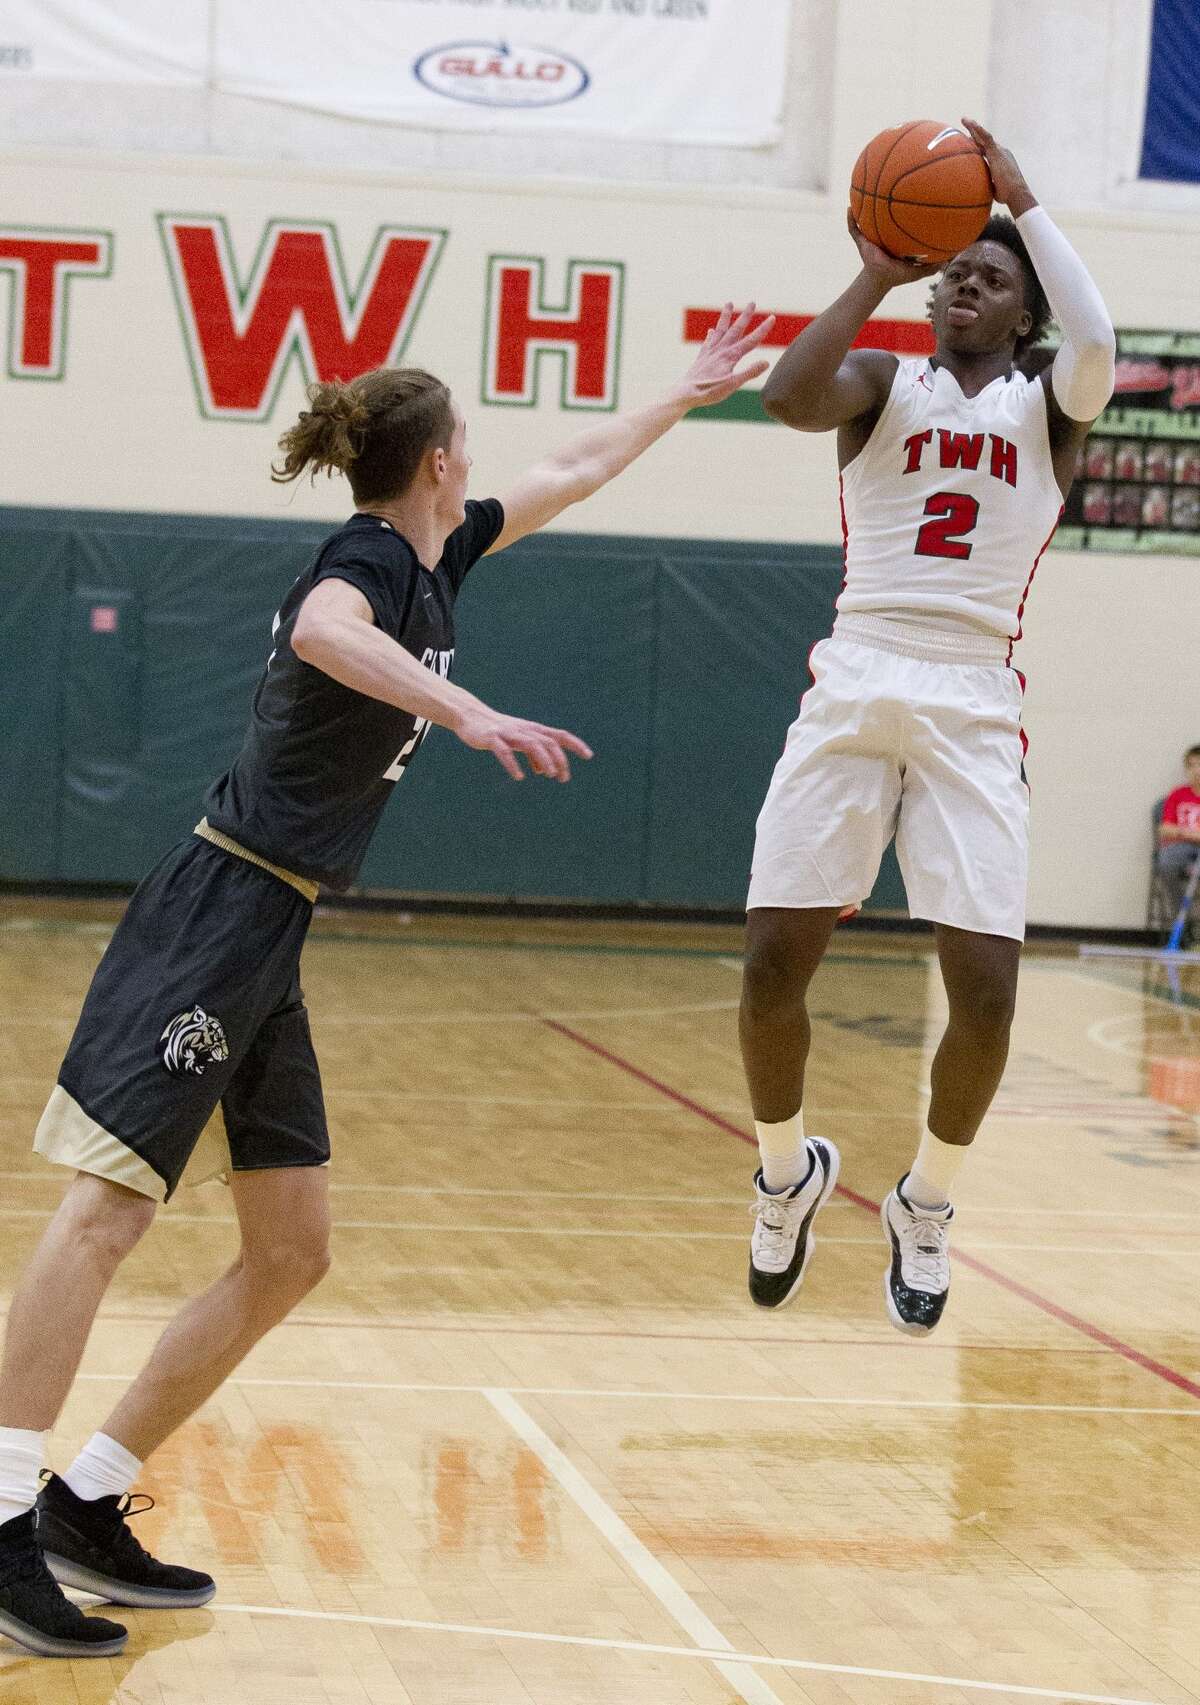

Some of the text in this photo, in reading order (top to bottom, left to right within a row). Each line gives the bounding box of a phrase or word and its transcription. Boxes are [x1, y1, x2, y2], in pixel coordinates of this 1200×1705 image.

[438, 57, 566, 82] GULLO
[903, 427, 1017, 489] TWH
[914, 491, 980, 560] 2
